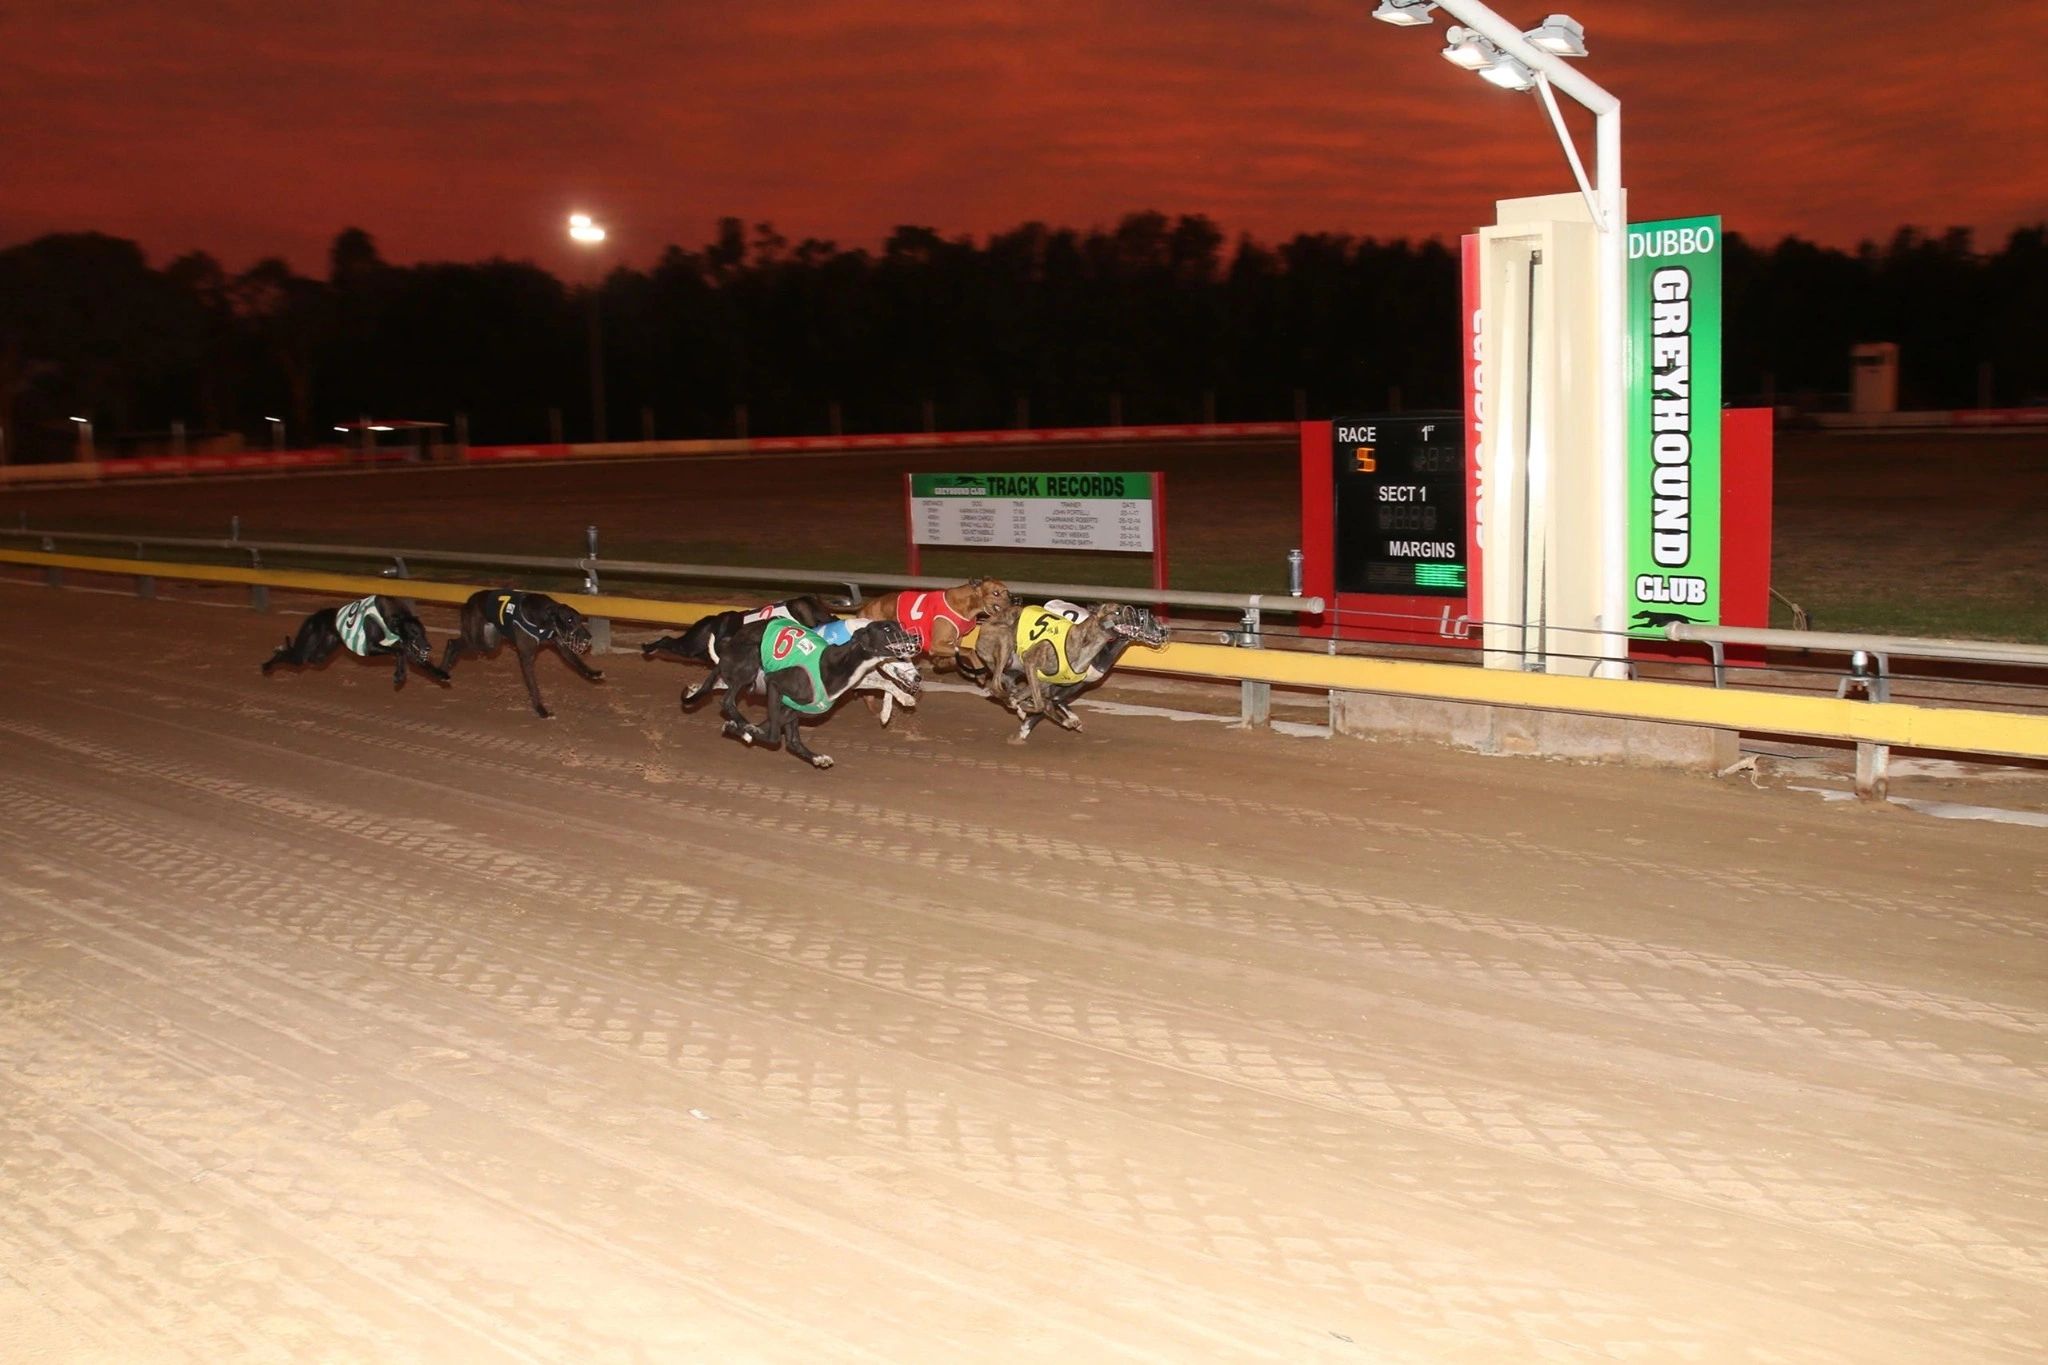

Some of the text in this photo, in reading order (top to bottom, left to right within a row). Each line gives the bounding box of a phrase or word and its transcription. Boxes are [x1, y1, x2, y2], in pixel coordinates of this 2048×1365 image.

[1629, 226, 1714, 259] DUBBO
[1651, 266, 1691, 567] GREYHOUND
[1338, 426, 1377, 443] RACE
[1357, 447, 1377, 472] 5
[986, 476, 1125, 497] TRACK RECORDS
[1378, 486, 1426, 502] SECT 1
[1389, 541, 1456, 558] MARGINS
[1635, 574, 1707, 605] CLUB
[498, 595, 511, 626] 7
[1029, 613, 1061, 641] 5
[773, 625, 806, 660] 6
